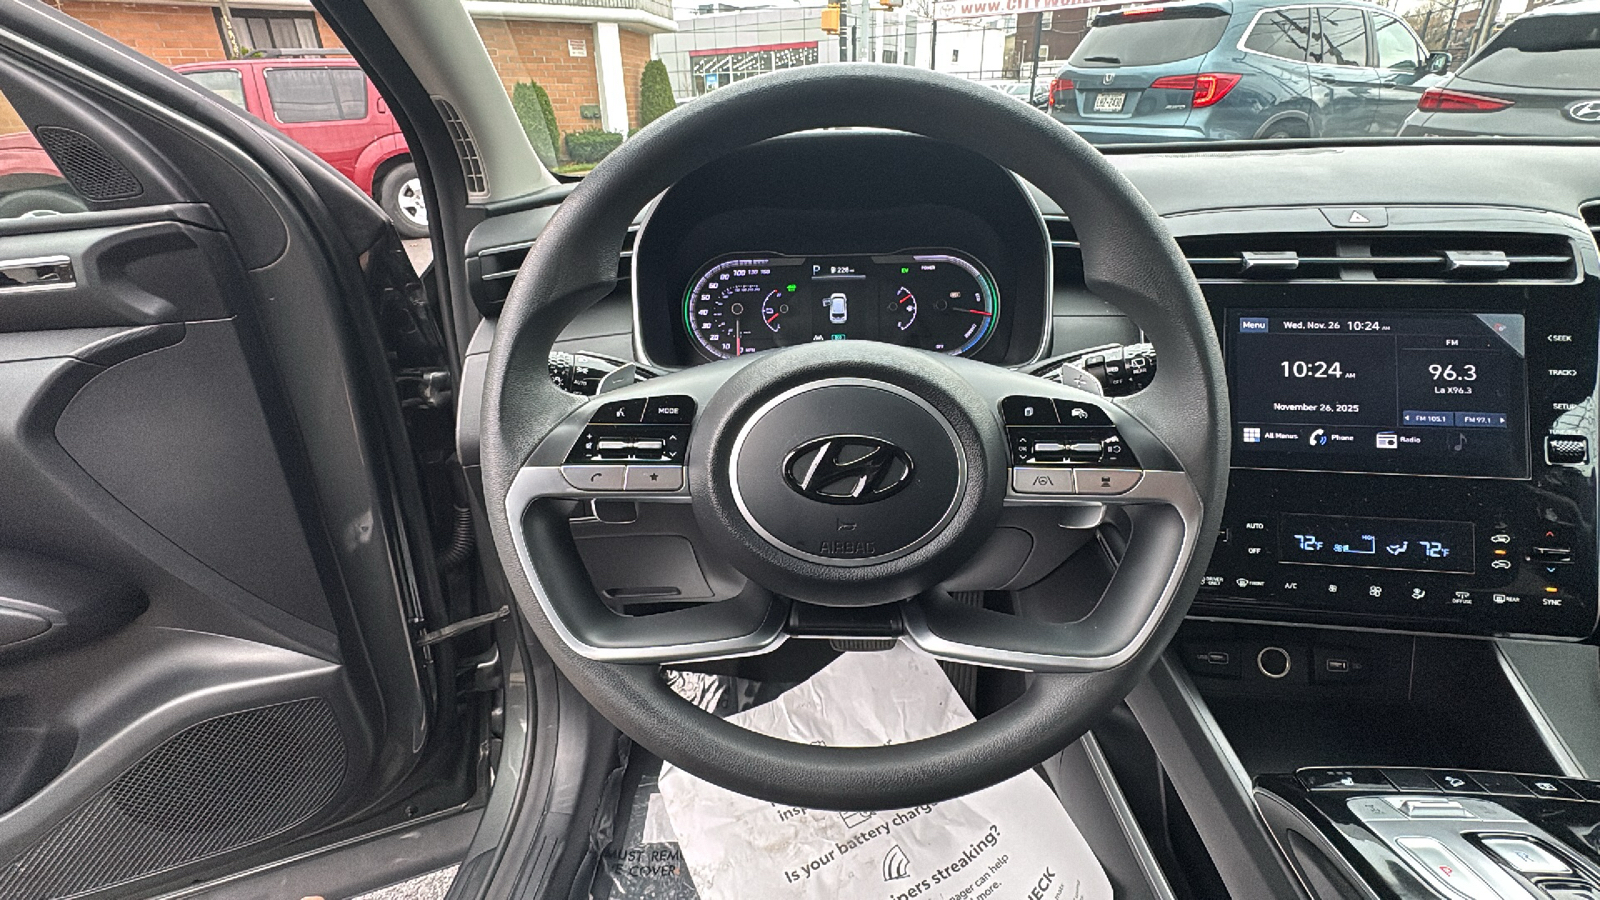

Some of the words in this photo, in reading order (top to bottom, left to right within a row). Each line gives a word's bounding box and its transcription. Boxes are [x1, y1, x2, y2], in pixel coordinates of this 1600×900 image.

[812, 264, 821, 276] P
[1242, 321, 1266, 329] Menu
[1328, 321, 1341, 330] 26
[1347, 321, 1380, 331] 10:24
[1280, 361, 1343, 379] 10:24
[1428, 364, 1477, 381] 96.3
[1434, 386, 1446, 394] La
[1447, 386, 1473, 394] X96.3
[658, 407, 679, 415] MODE
[1273, 402, 1318, 411] November
[1336, 404, 1360, 413] 2025
[1400, 436, 1421, 444] Radio
[820, 541, 877, 554] AIRBAG
[784, 870, 801, 884] Is
[800, 849, 836, 879] your
[835, 821, 891, 855] battery
[930, 824, 1001, 885] streaking?
[629, 864, 676, 877] COVER
[974, 871, 991, 888] can
[990, 854, 1009, 875] help
[978, 881, 1003, 900] more.
